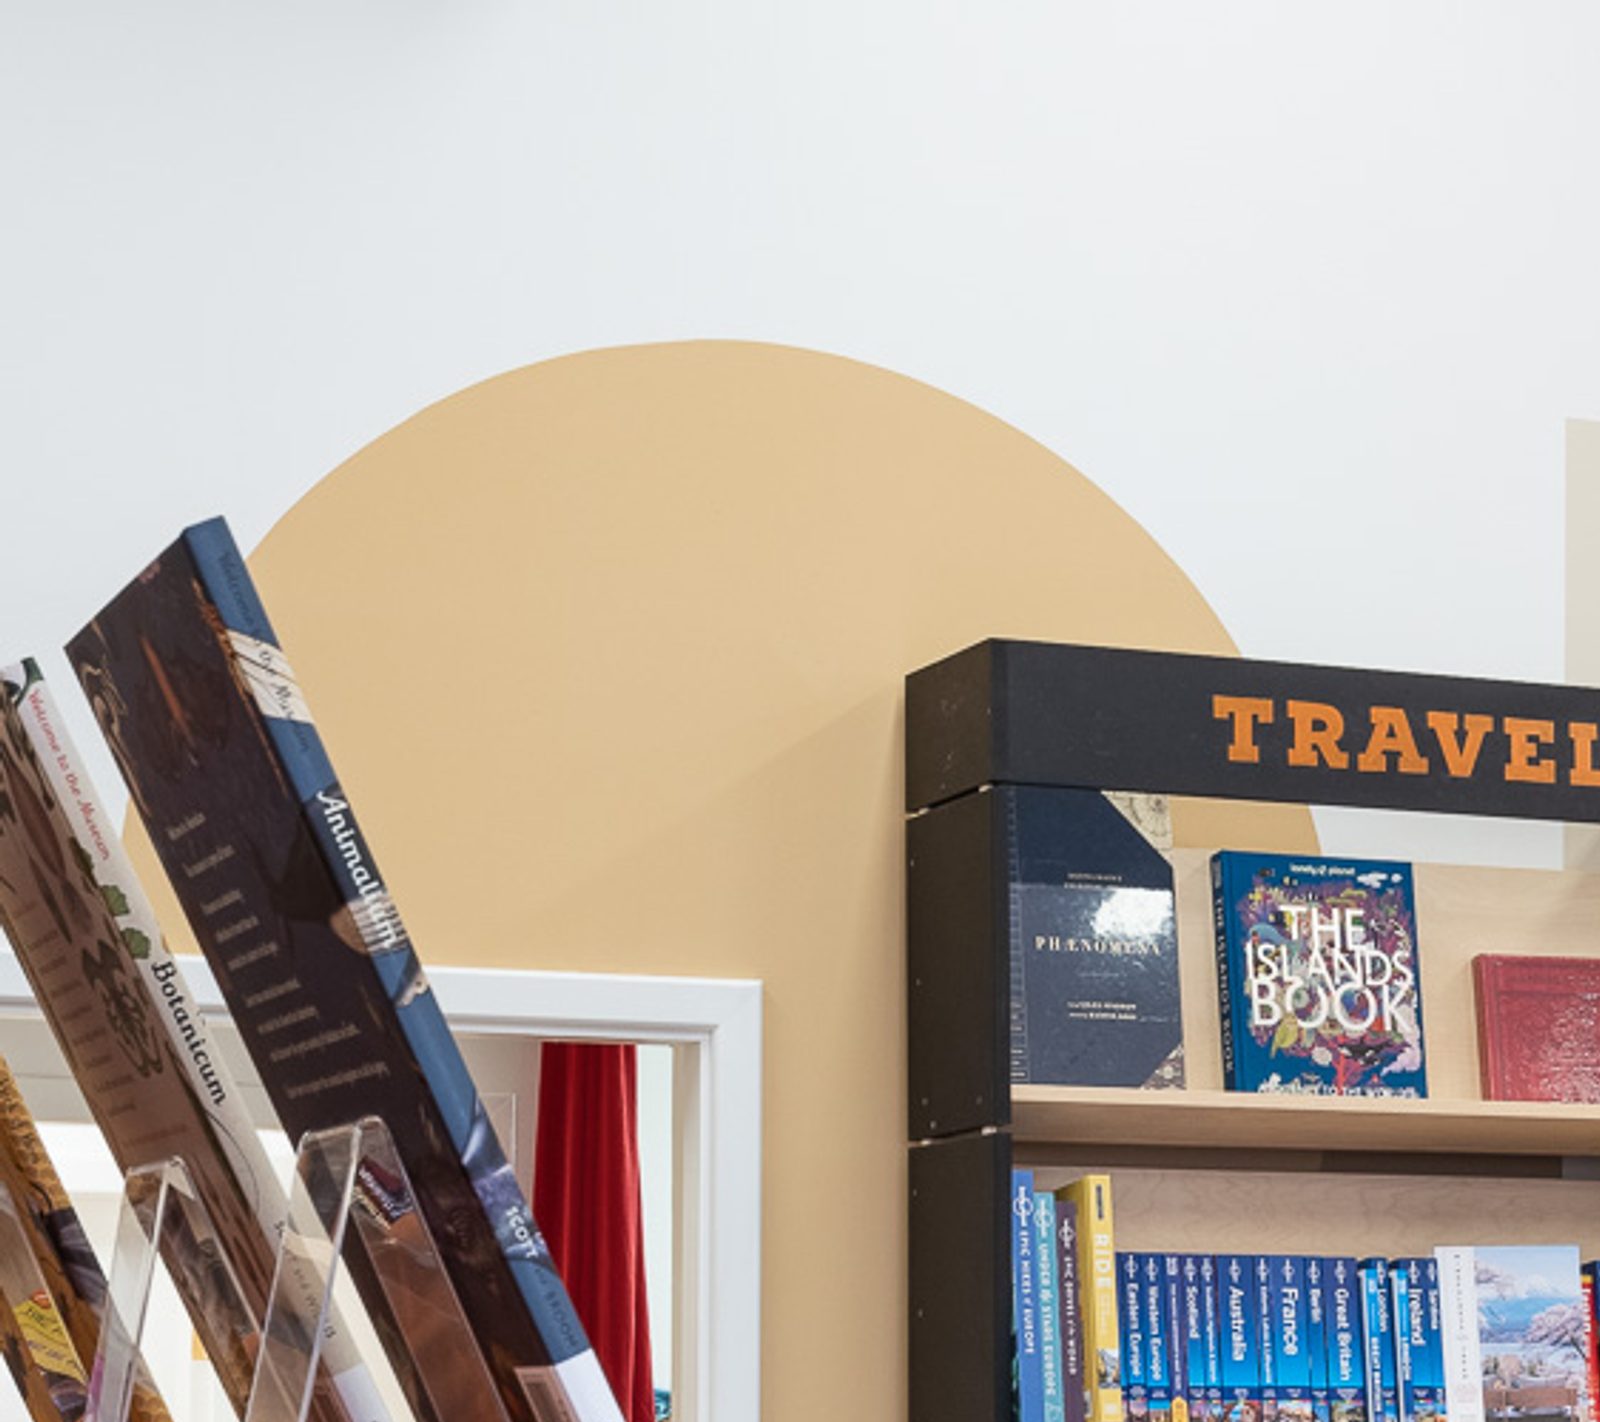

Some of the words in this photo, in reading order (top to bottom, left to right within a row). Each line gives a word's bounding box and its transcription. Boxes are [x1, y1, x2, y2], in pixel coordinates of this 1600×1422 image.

[28, 692, 64, 752] Welcome
[58, 752, 71, 771] to
[65, 772, 82, 797] the
[77, 798, 110, 860] Museum
[317, 790, 400, 949] Animalium
[1279, 905, 1365, 945] THE
[1245, 942, 1413, 986] ISLANDS
[1252, 978, 1413, 1032] BOOK
[151, 961, 226, 1105] Botanicum
[504, 1205, 539, 1259] SCOTT
[1094, 1233, 1112, 1289] RIDE
[1187, 1286, 1199, 1339] Scotland
[1229, 1286, 1246, 1361] Australia
[1282, 1288, 1298, 1355] France
[1335, 1289, 1349, 1329] Great
[1377, 1289, 1388, 1332] London
[1409, 1289, 1424, 1345] Ireland
[1338, 1332, 1351, 1381] Britain
